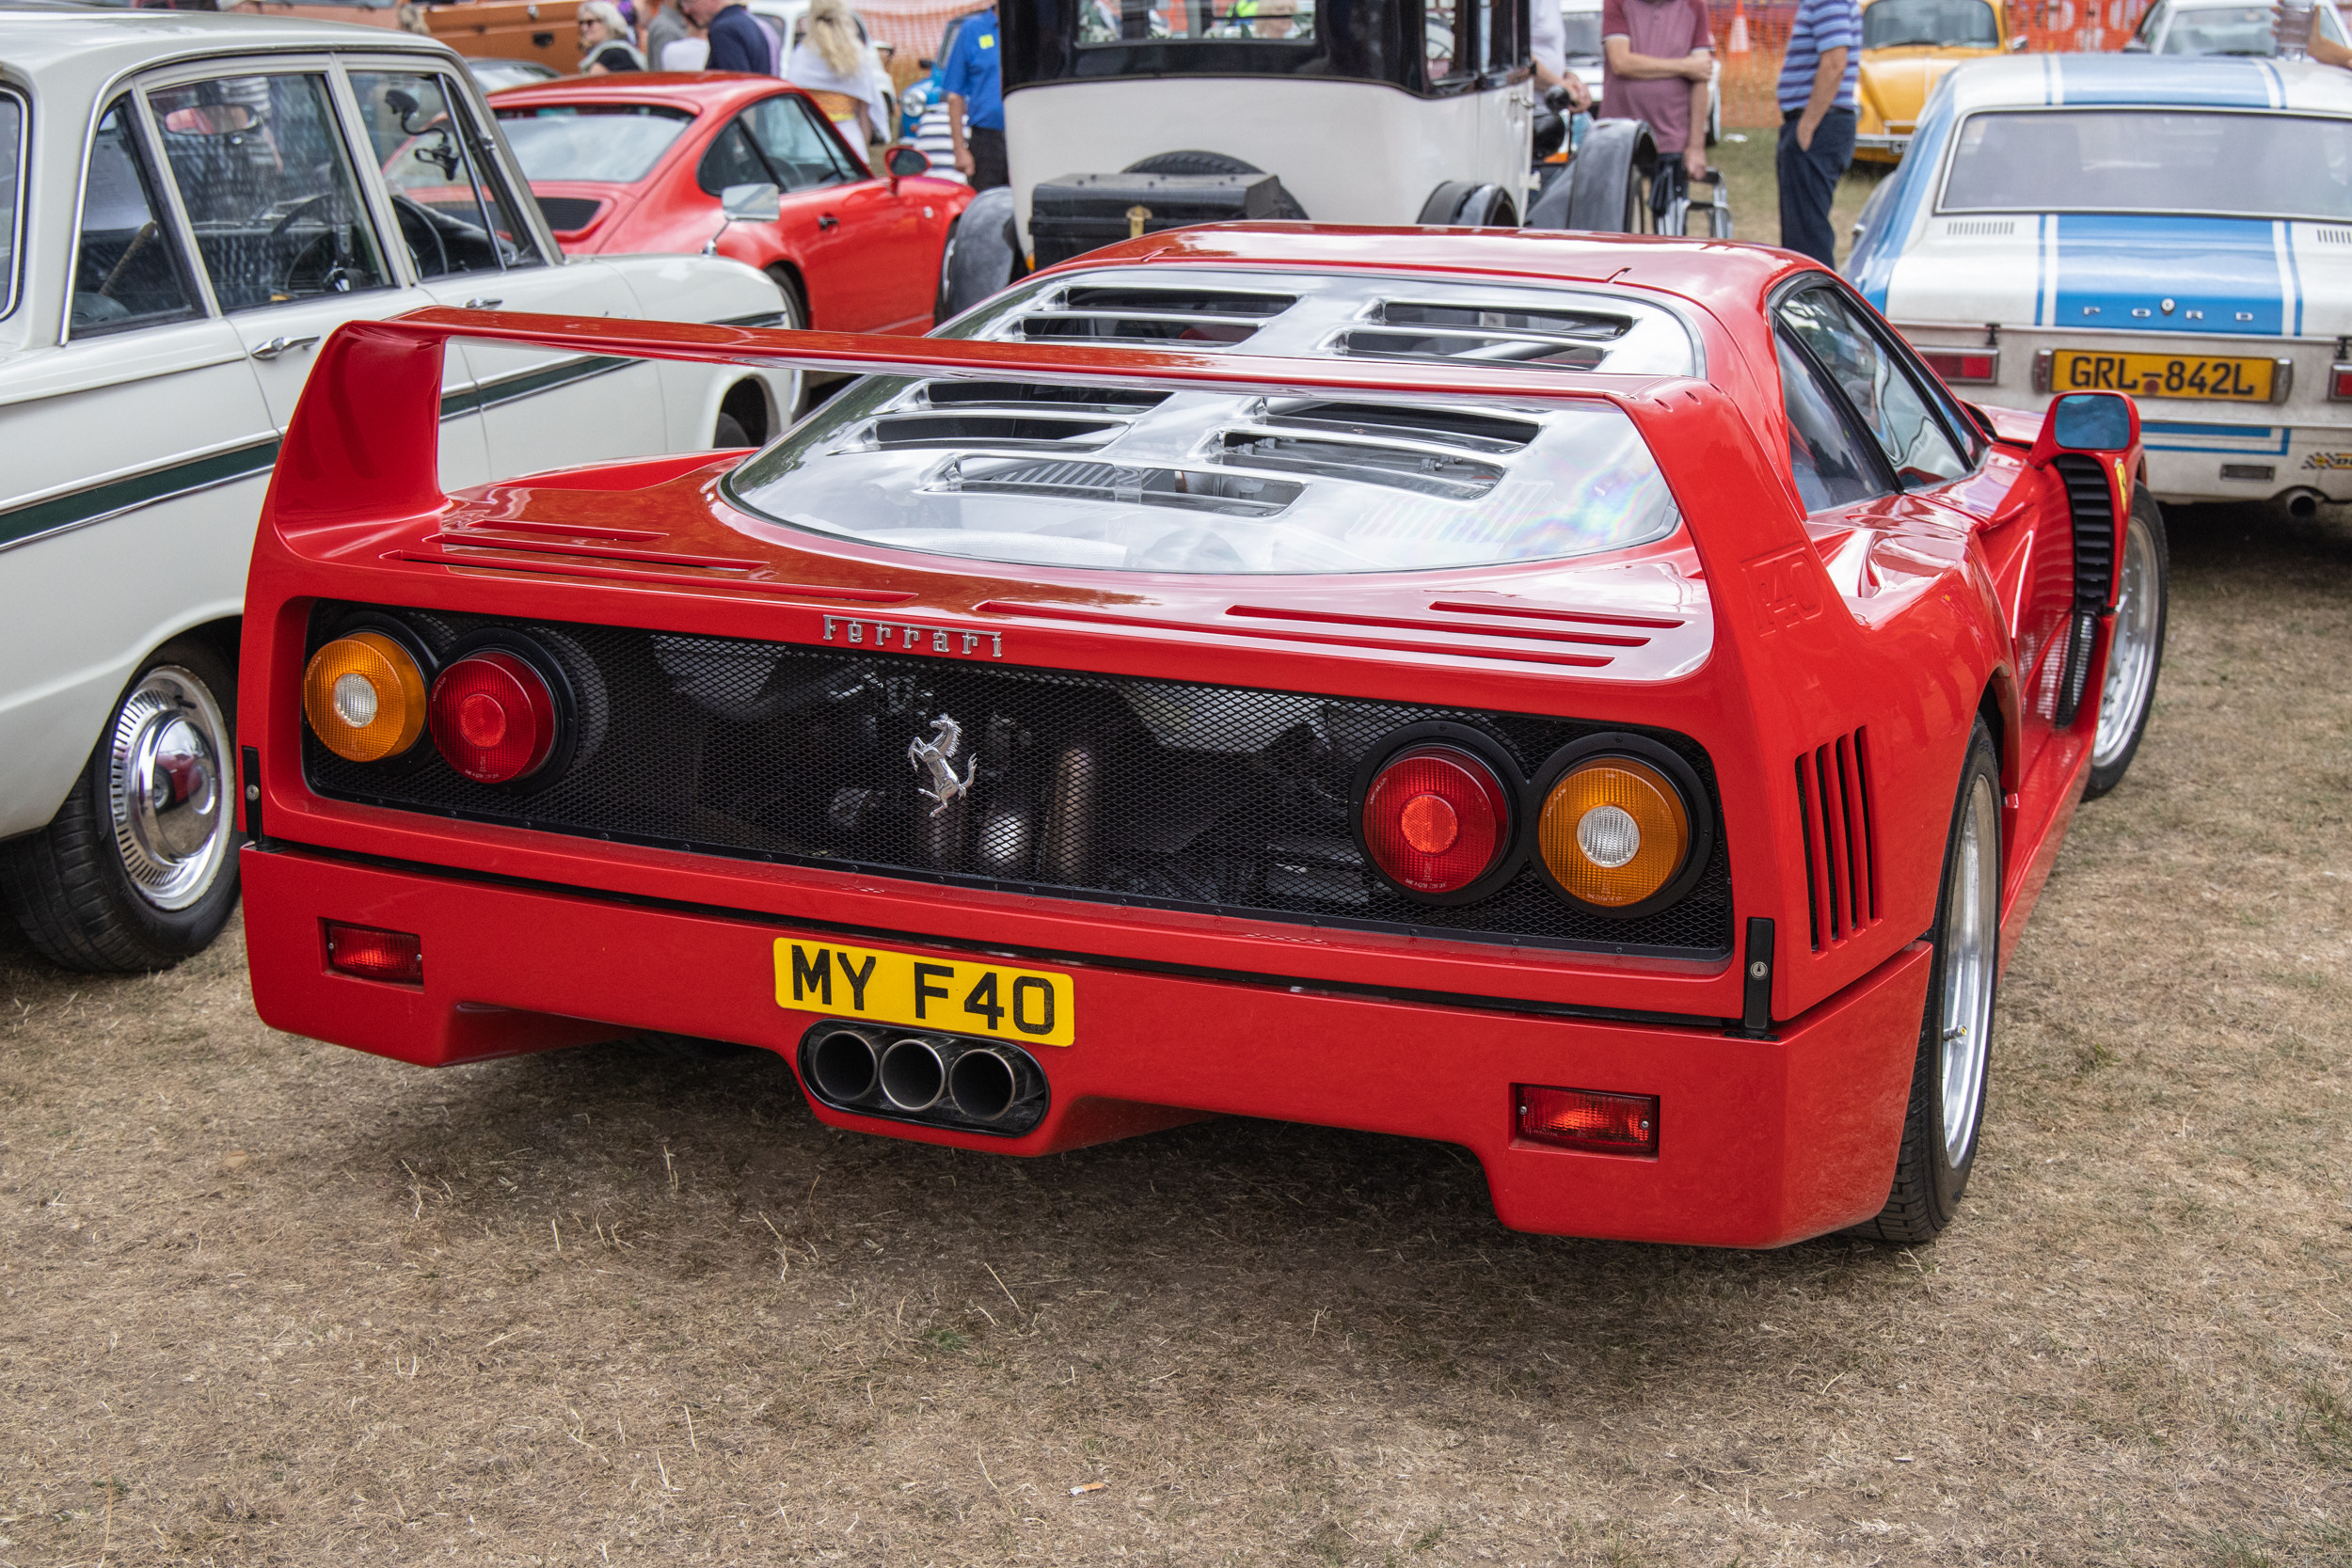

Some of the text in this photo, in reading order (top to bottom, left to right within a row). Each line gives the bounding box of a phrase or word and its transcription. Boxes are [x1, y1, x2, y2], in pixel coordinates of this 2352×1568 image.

[2083, 306, 2253, 321] FORD
[2070, 356, 2254, 395] GRL-842L
[1740, 541, 1823, 637] F40
[823, 614, 1002, 657] Ferrari
[791, 944, 1055, 1035] MY F40
